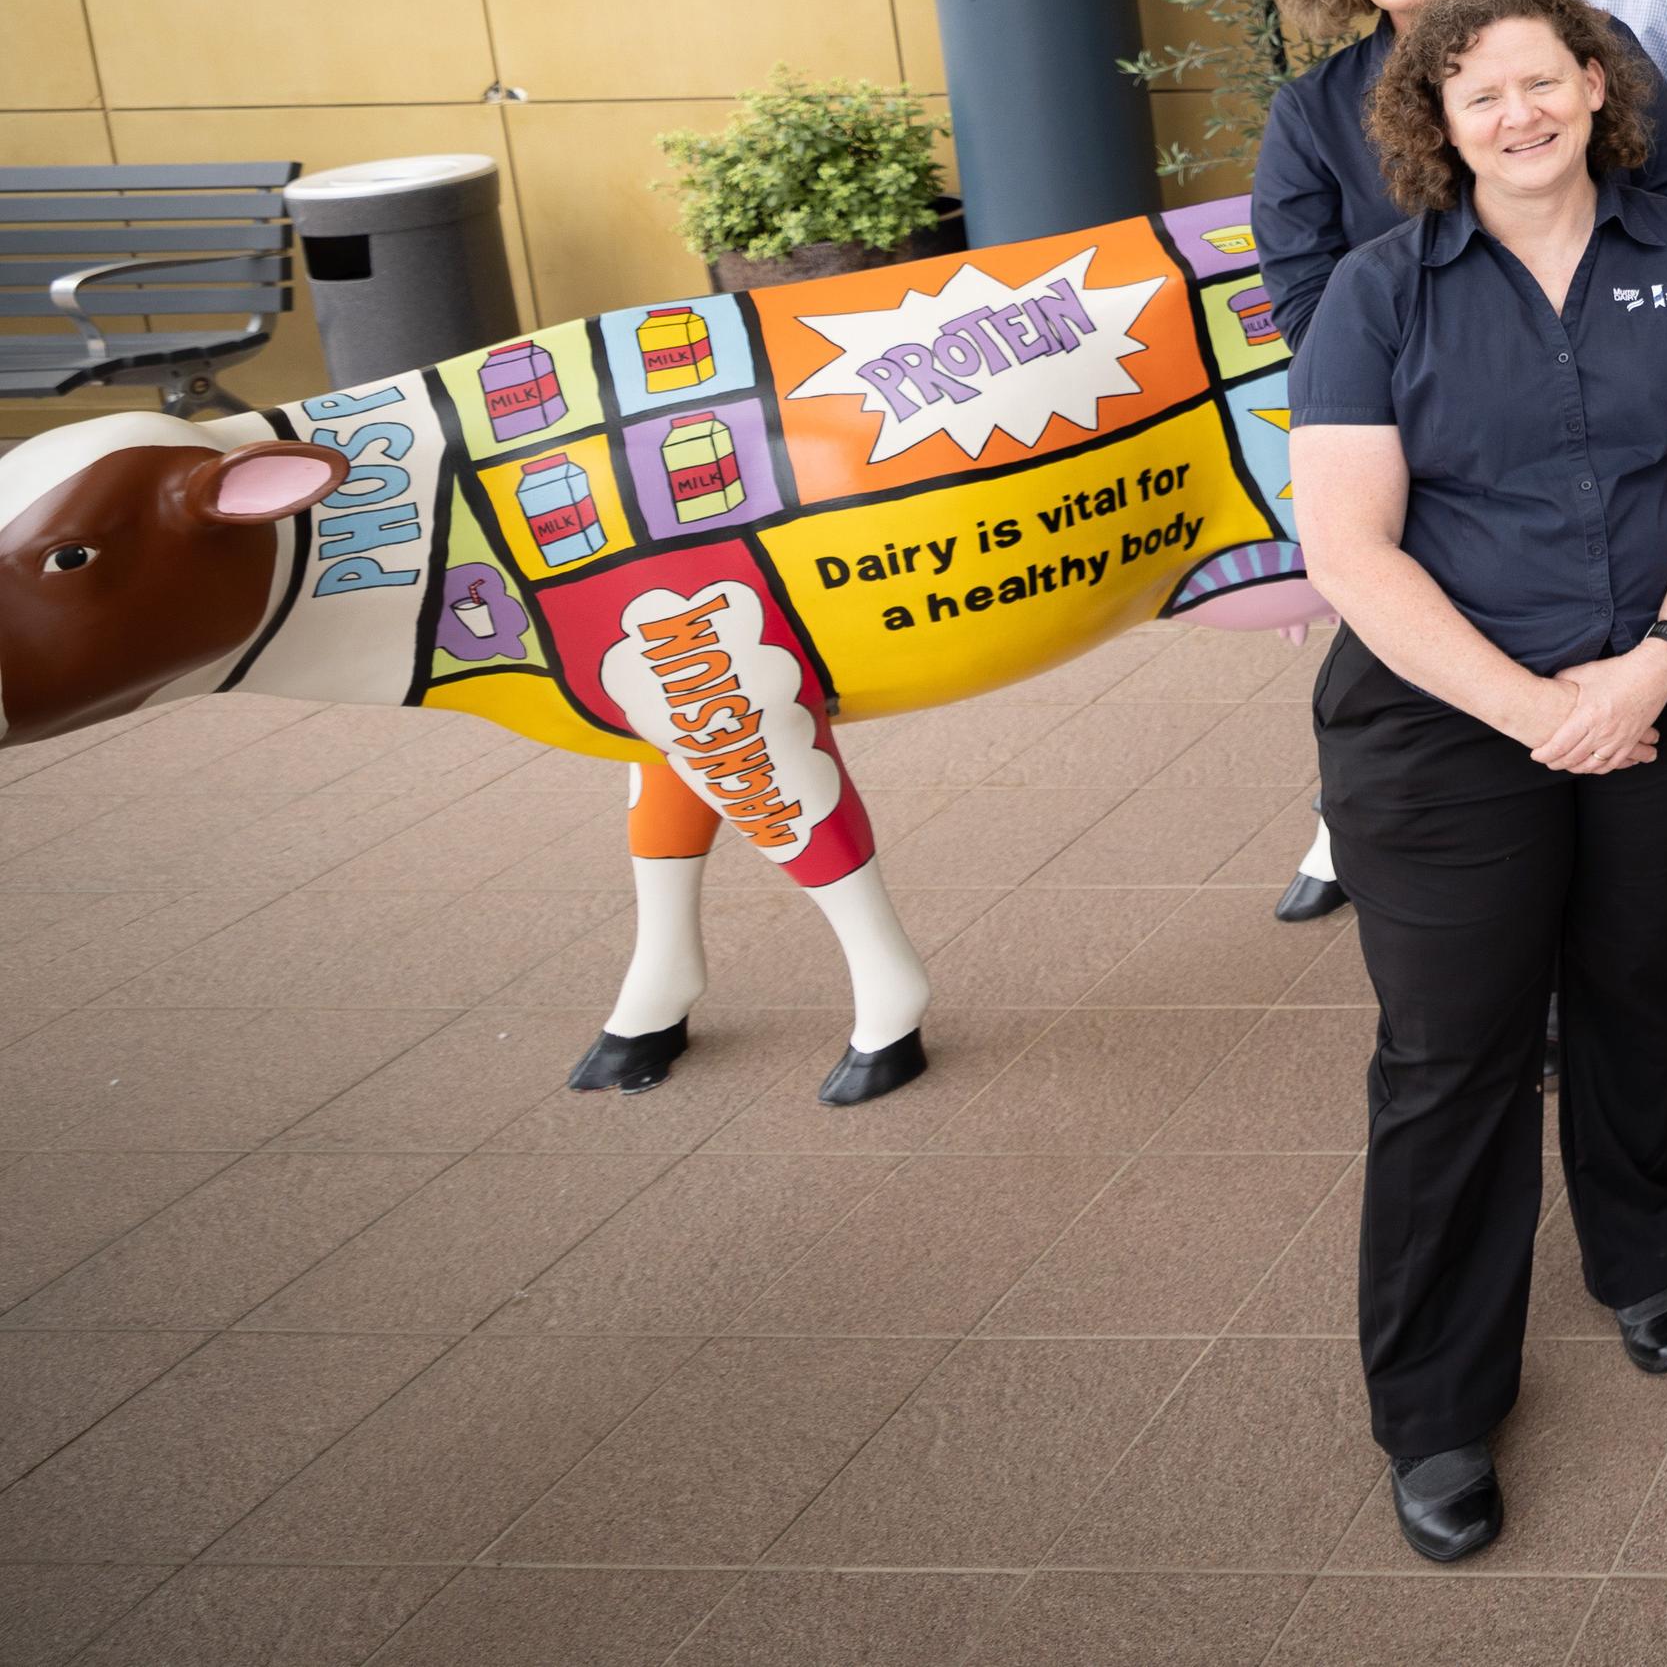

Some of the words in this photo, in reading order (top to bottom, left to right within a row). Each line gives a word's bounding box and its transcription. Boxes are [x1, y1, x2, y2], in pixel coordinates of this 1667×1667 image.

[647, 351, 691, 368] MILK
[855, 277, 1098, 423] PROTEIN
[490, 386, 538, 411] MILK
[677, 471, 724, 494] MILK
[537, 515, 576, 538] MILK
[814, 534, 958, 591] Dairy
[976, 517, 1024, 555] is
[1036, 477, 1129, 535] vital
[1136, 461, 1191, 503] for
[881, 604, 916, 632] a
[926, 548, 1110, 624] healthy
[1120, 511, 1206, 566] body
[637, 593, 803, 848] MAGNESIUM
